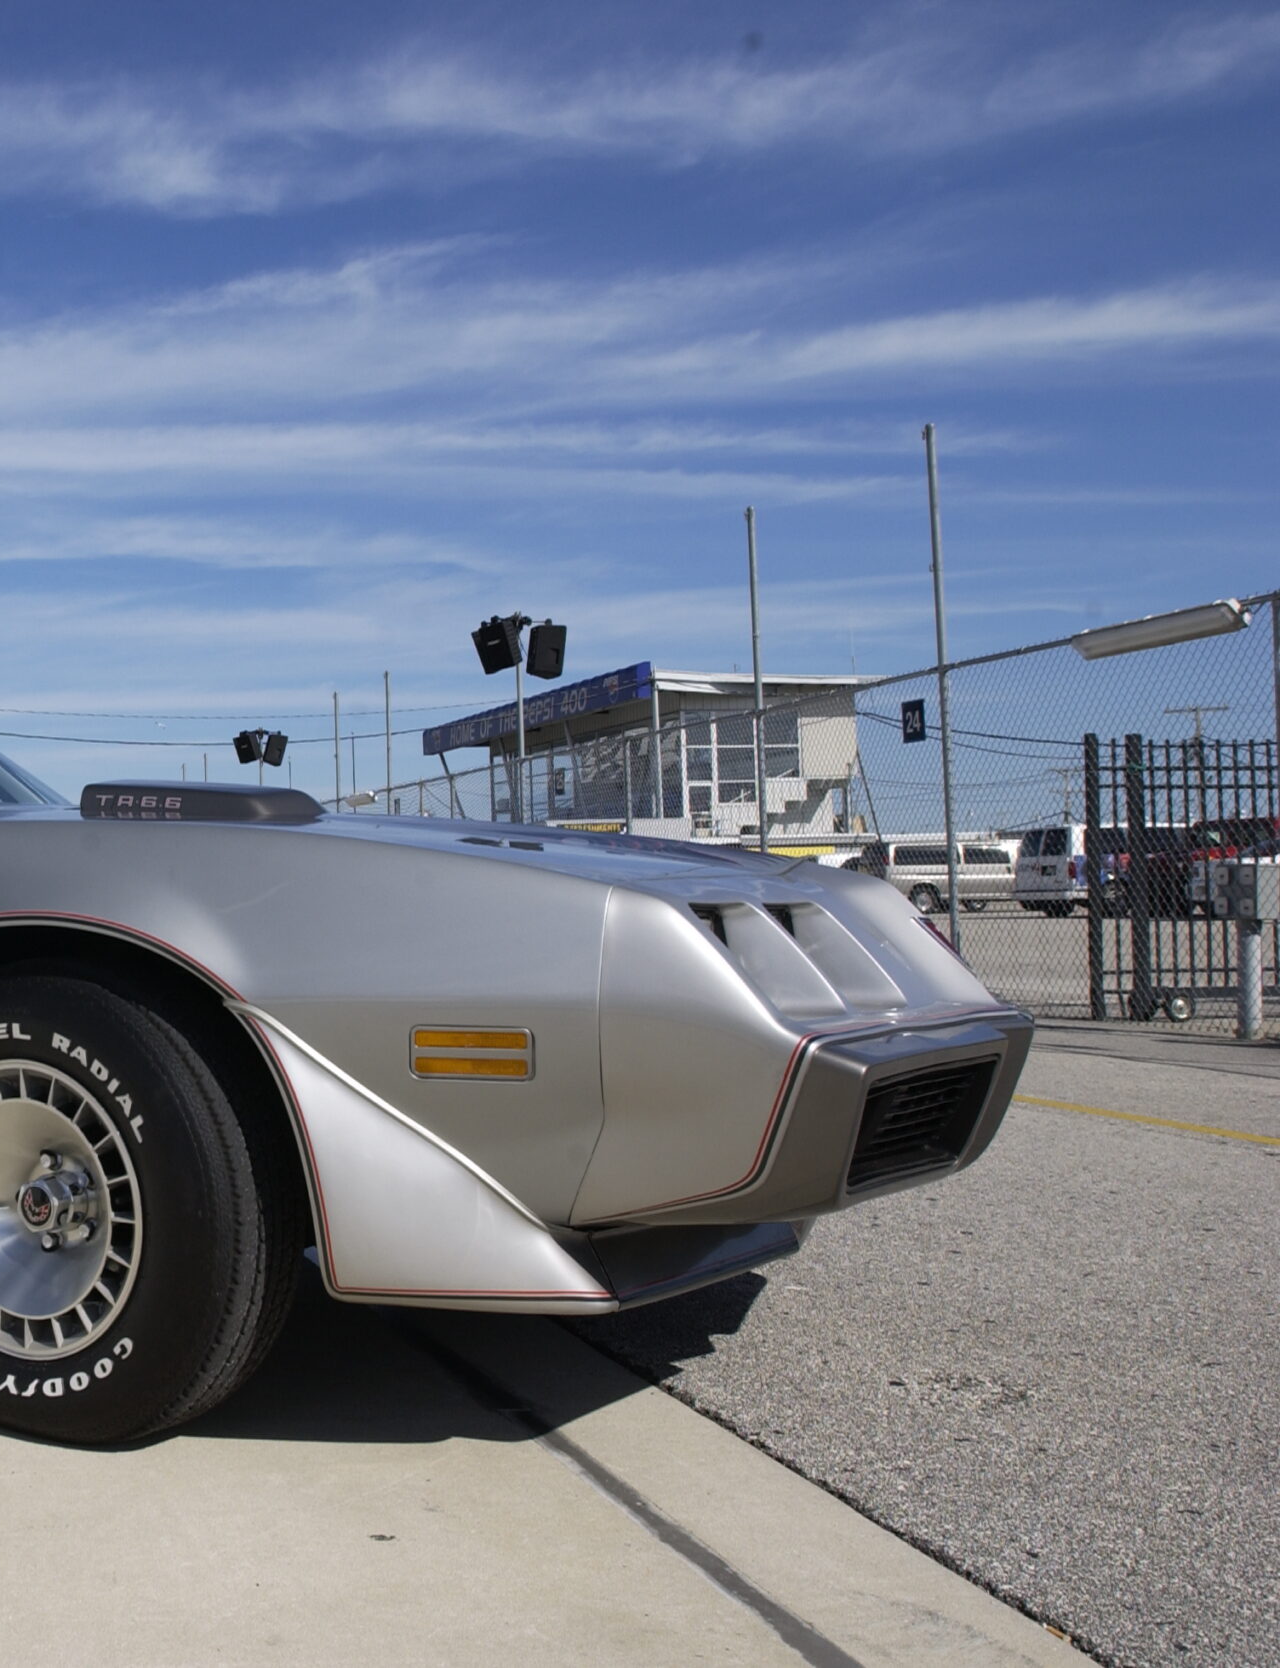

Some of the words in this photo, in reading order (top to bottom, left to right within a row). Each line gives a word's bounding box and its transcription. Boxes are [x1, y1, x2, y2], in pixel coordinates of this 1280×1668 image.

[449, 720, 475, 748] HOME
[479, 716, 493, 738] OF
[498, 709, 517, 734] THE
[523, 696, 554, 726] PEPSI
[560, 686, 587, 715] 400
[905, 710, 921, 733] 24
[52, 1032, 146, 1144] RADIAL
